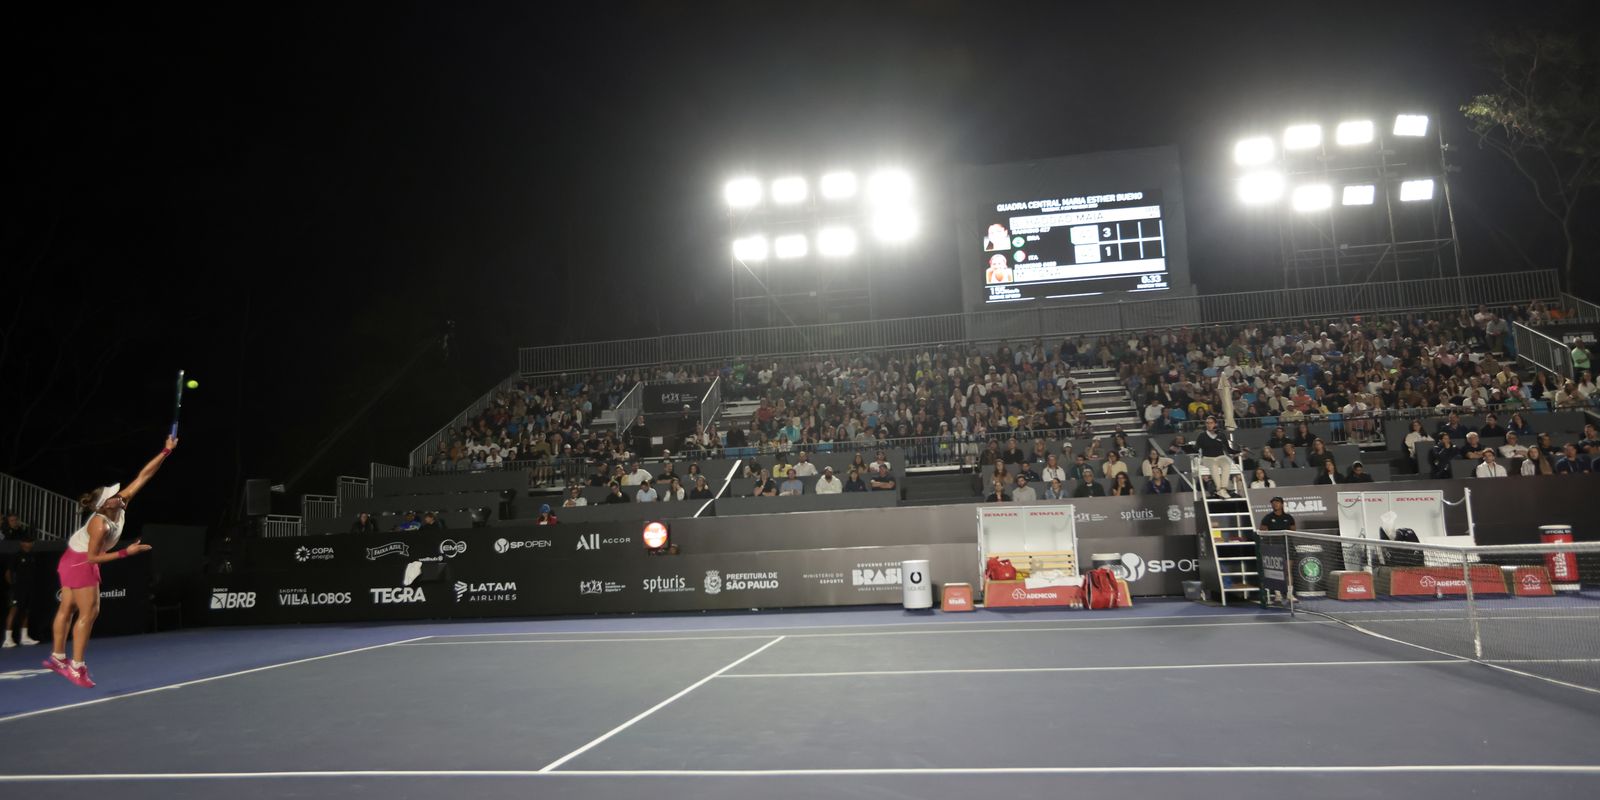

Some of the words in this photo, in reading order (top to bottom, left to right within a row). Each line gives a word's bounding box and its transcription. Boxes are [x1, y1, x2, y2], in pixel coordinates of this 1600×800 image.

[997, 202, 1027, 212] QUADRA
[1028, 199, 1061, 210] CENTRAL
[1062, 197, 1086, 206] MARIA
[1086, 194, 1115, 204] ESTHER
[1116, 192, 1144, 202] BUENO
[1103, 228, 1111, 237] 3
[1105, 246, 1111, 256] 1
[1120, 508, 1154, 521] spturis
[510, 541, 524, 549] SP
[525, 540, 551, 548] OPEN
[1147, 559, 1175, 573] SP
[1177, 559, 1200, 572] OP
[726, 572, 767, 580] PREFEITURA
[768, 571, 778, 579] DE
[852, 568, 902, 586] BRASI
[470, 582, 516, 592] LATAM
[643, 575, 685, 593] spturis
[726, 580, 746, 590] SÃO
[747, 580, 779, 590] PAULO
[100, 588, 126, 598] ential
[279, 593, 309, 605] VILLA
[311, 592, 352, 605] LOBOS
[370, 586, 426, 604] TEGRA
[226, 592, 257, 609] BRB
